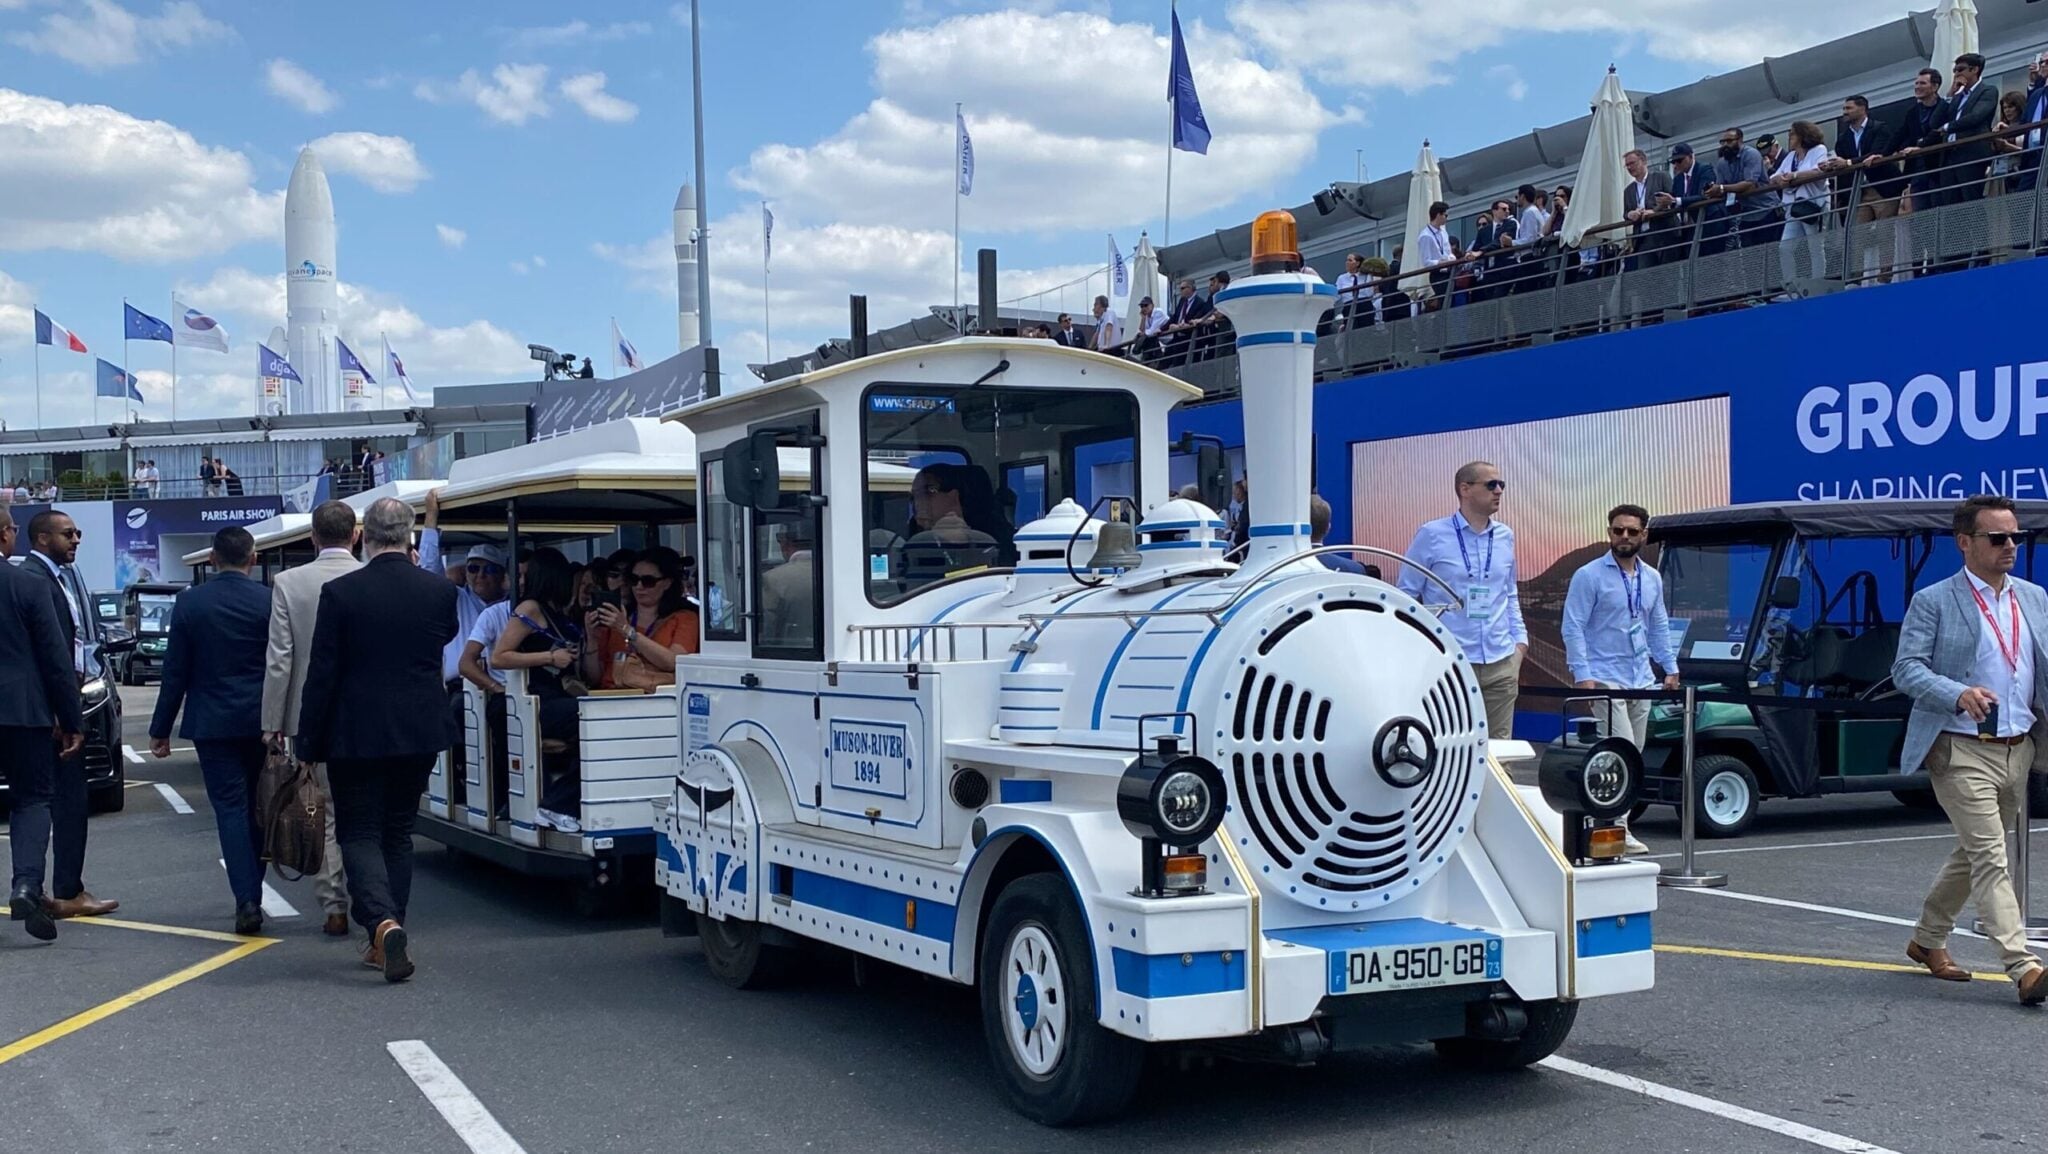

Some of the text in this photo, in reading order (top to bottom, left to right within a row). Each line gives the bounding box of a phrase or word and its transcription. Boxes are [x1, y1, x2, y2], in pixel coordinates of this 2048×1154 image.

[962, 135, 970, 175] DAHER
[1115, 253, 1124, 284] DAHER
[1796, 361, 2048, 454] GROUP
[1797, 466, 2048, 501] SHAPING NE
[201, 508, 276, 521] PARIS AIR SHOW
[854, 760, 881, 784] 1894
[1350, 943, 1485, 985] DA-950-GB
[1487, 961, 1500, 976] 73
[1335, 975, 1342, 985] F
